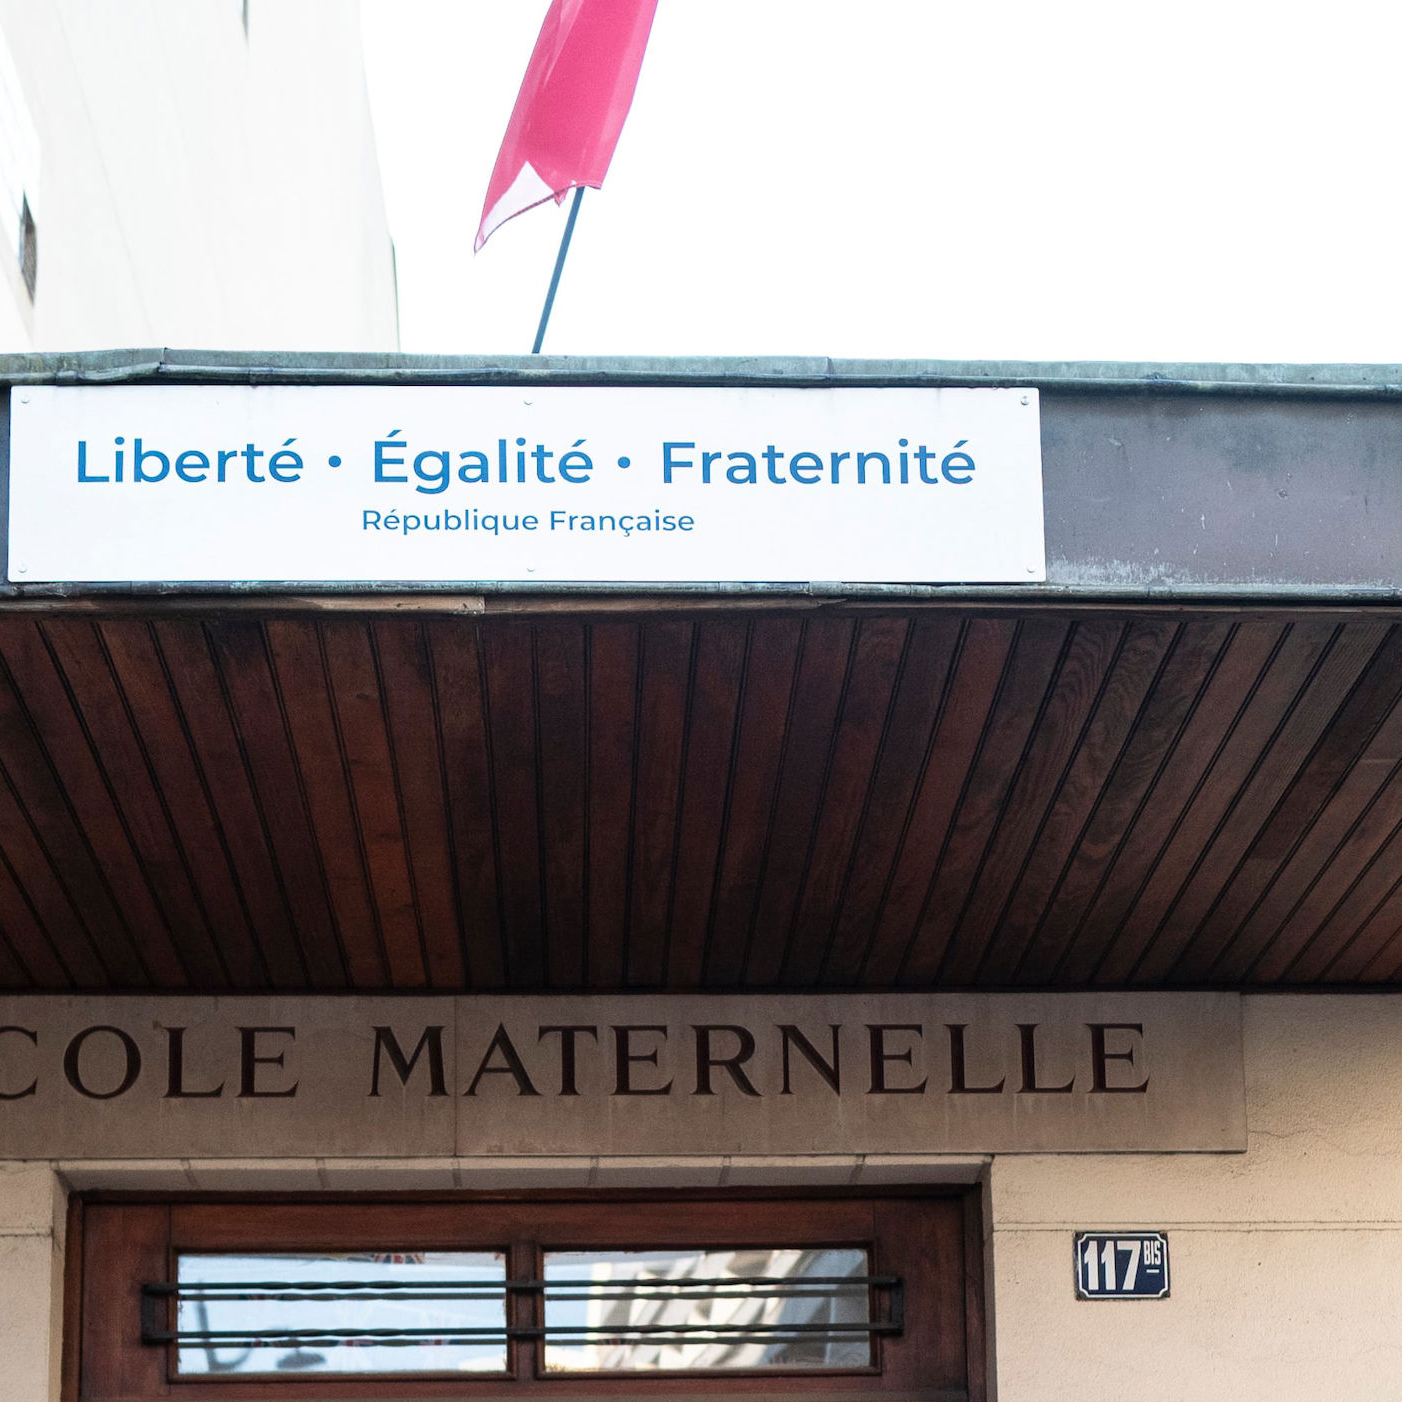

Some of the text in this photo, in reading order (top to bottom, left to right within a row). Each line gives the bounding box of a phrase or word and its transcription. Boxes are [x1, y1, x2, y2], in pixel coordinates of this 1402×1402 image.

[77, 428, 976, 495] Liberté Égalité Fraternité
[362, 508, 695, 537] République Française
[368, 1020, 1152, 1098] MATERNELLE
[1084, 1240, 1162, 1291] 117 BIS
